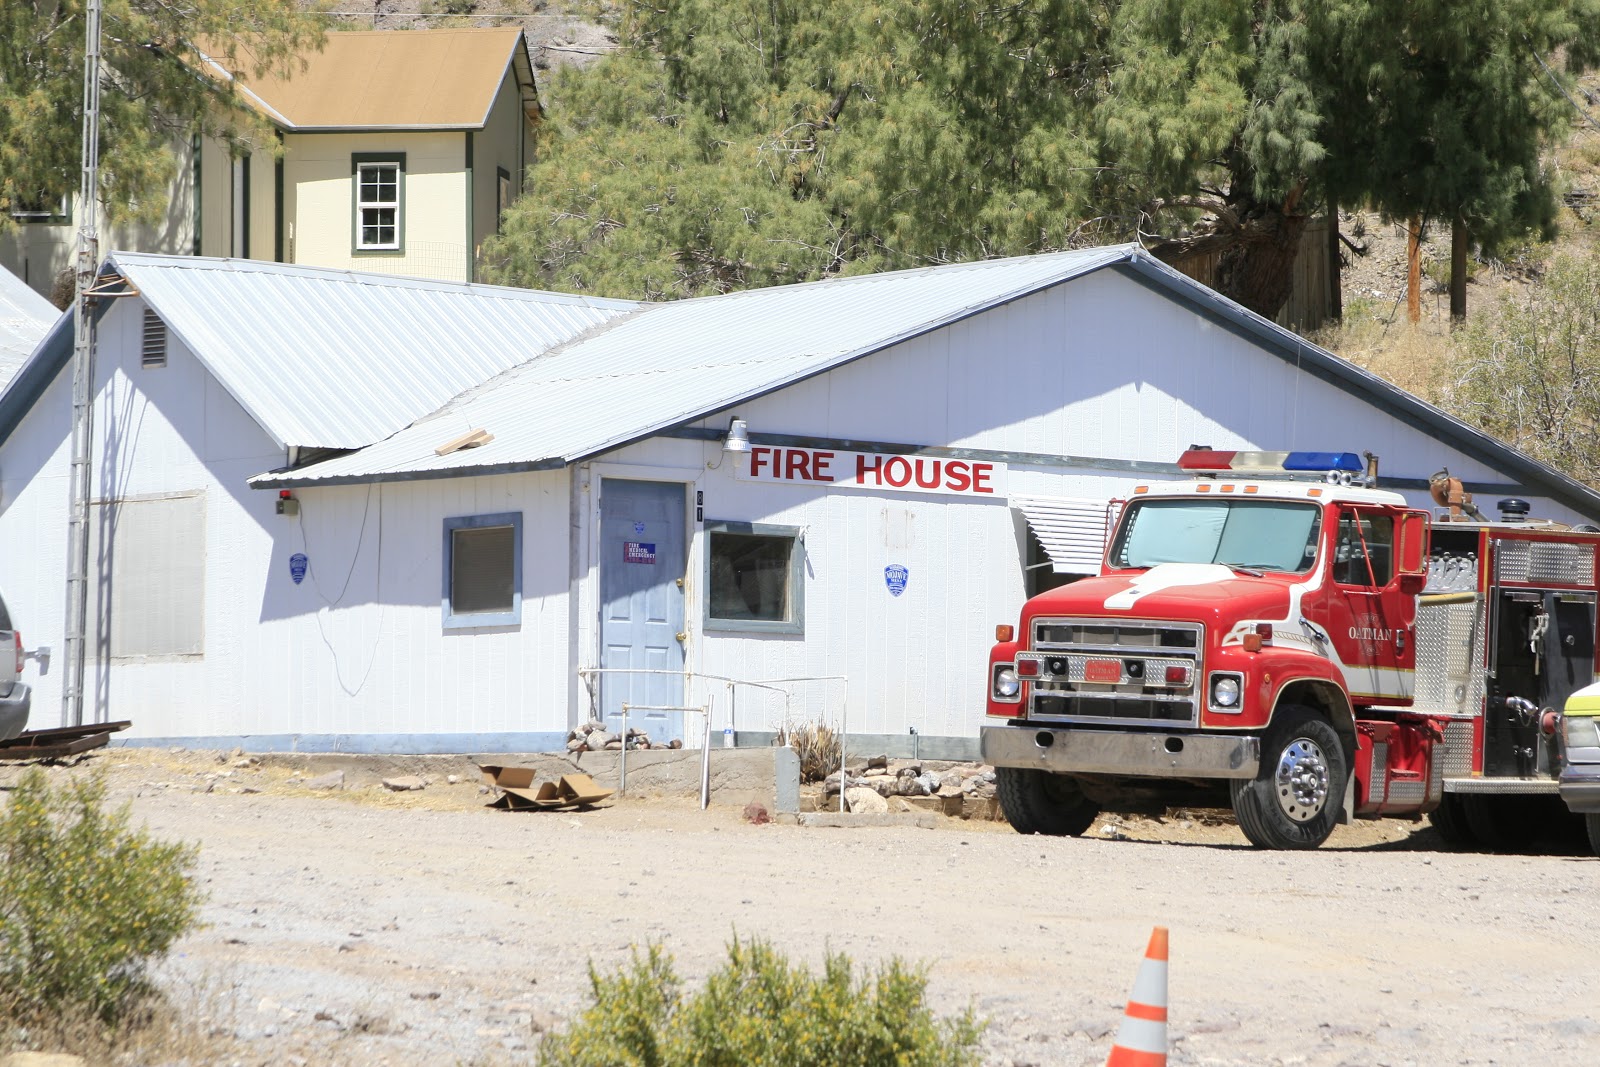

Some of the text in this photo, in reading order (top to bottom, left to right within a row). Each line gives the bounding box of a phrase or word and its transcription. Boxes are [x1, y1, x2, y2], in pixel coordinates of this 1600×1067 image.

[750, 447, 993, 493] FIRE HOUSE
[1348, 626, 1392, 641] OATMAN
